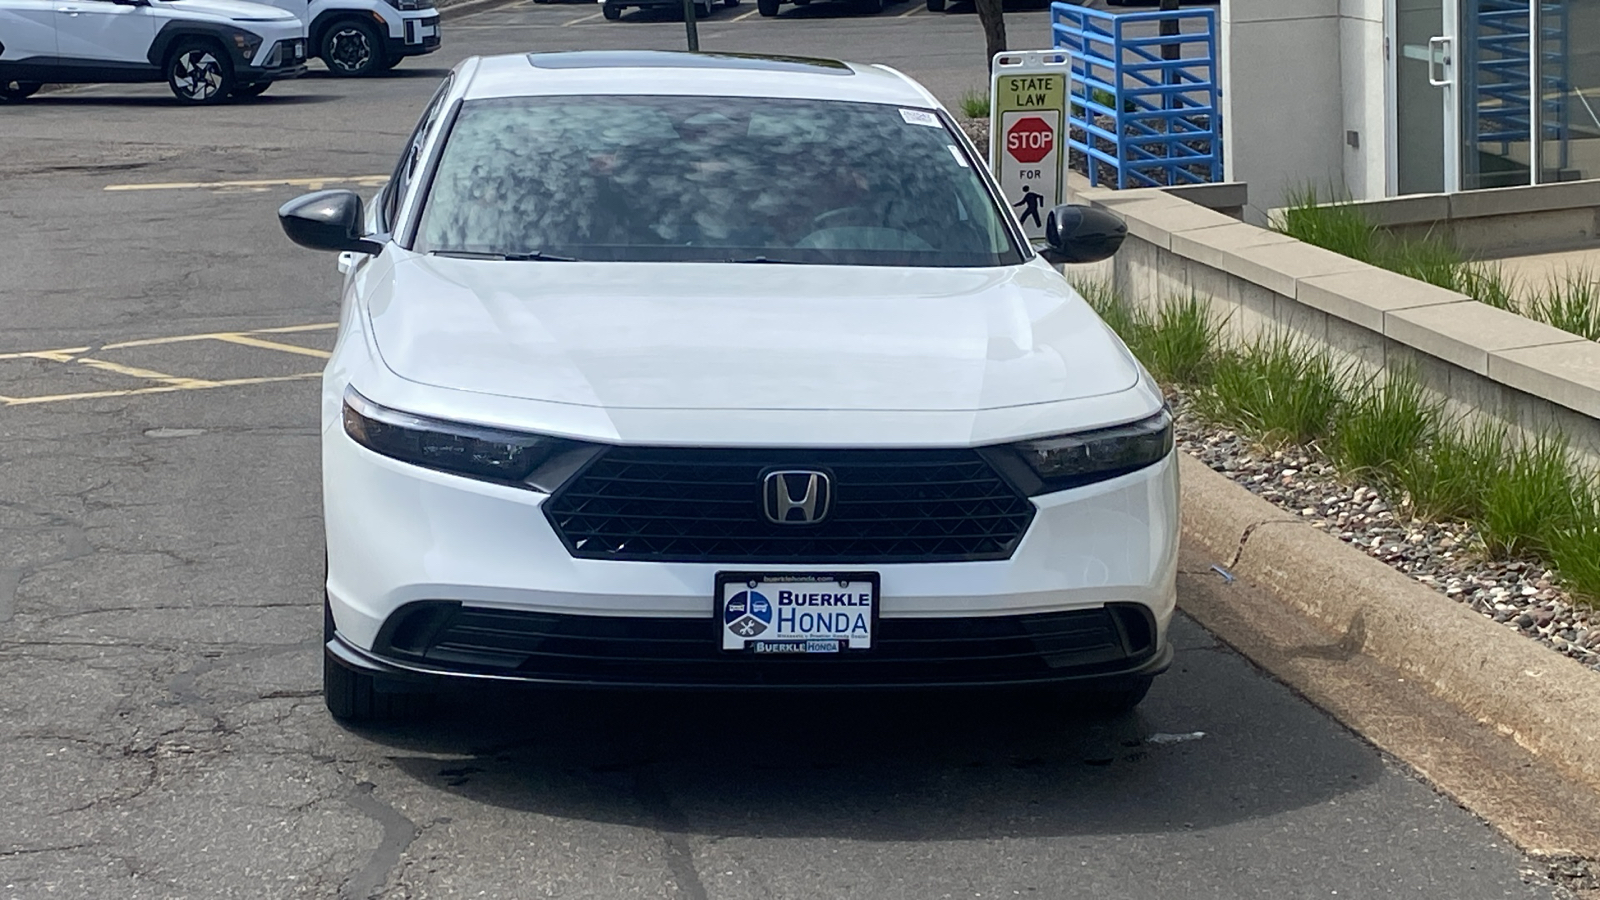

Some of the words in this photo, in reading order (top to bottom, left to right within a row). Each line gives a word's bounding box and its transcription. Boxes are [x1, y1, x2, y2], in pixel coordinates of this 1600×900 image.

[1010, 78, 1053, 91] STATE
[1016, 94, 1046, 106] LAW
[1008, 132, 1053, 149] STOP
[1020, 170, 1041, 179] FOR
[778, 590, 870, 606] BUERKLE
[777, 607, 868, 633] HONDA
[756, 642, 806, 652] BUERKLE
[807, 642, 838, 652] HONDA
